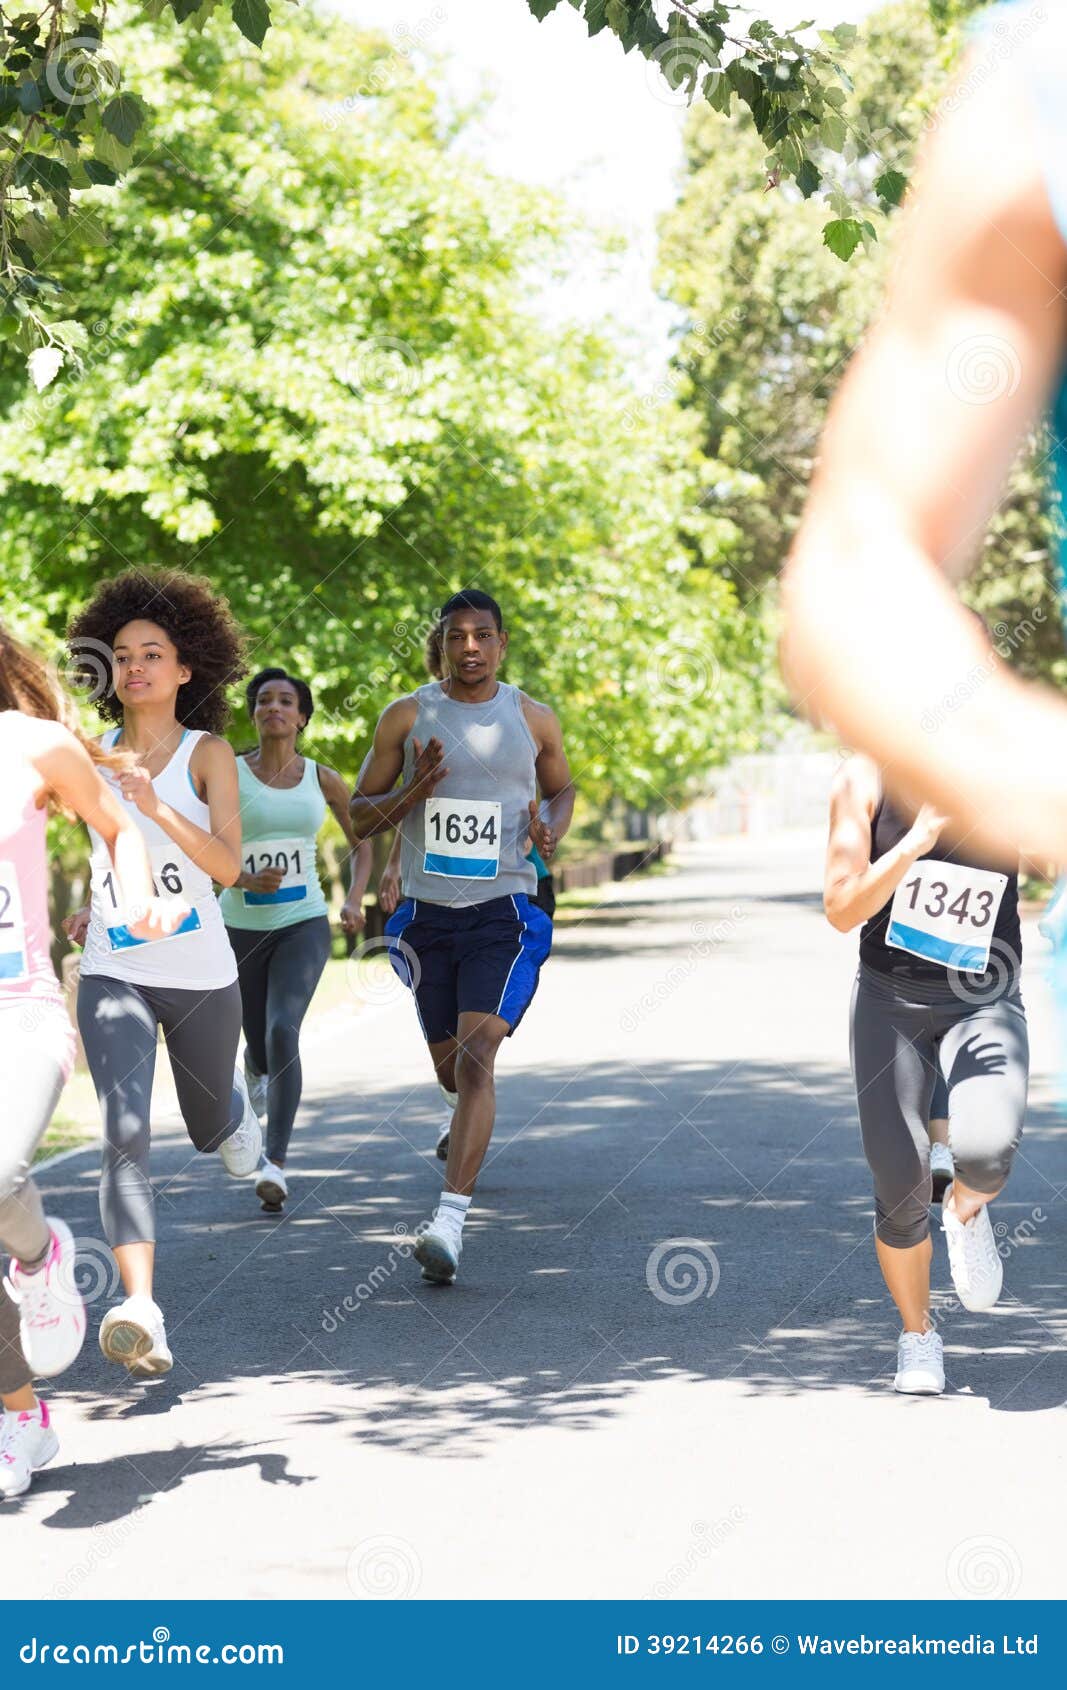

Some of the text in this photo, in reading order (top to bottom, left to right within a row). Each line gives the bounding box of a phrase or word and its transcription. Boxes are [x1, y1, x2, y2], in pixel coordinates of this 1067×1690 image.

[430, 811, 497, 846] 1634
[102, 862, 183, 908] 16
[905, 877, 994, 928] 1343
